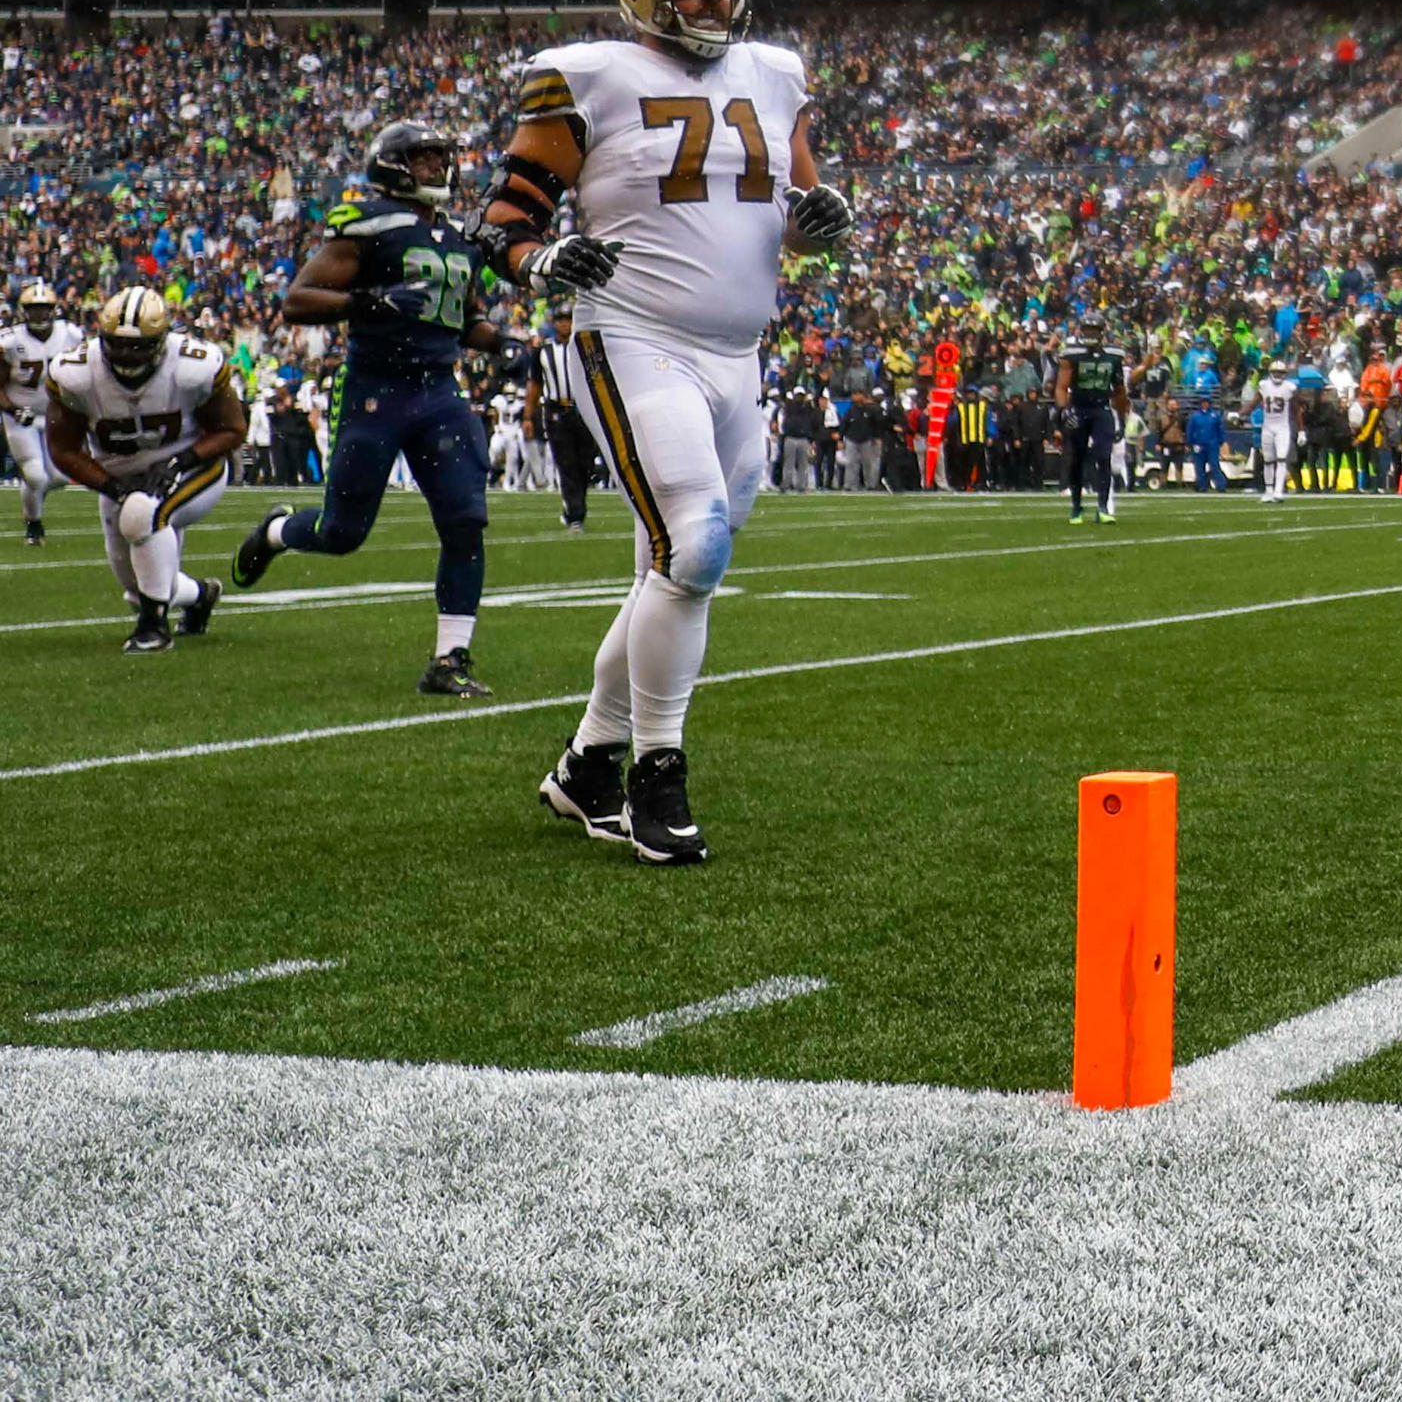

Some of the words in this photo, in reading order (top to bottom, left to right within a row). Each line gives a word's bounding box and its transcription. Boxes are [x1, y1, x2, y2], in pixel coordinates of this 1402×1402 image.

[638, 95, 776, 205] 71
[20, 360, 44, 389] 7
[917, 354, 934, 376] 2
[95, 410, 183, 455] 67
